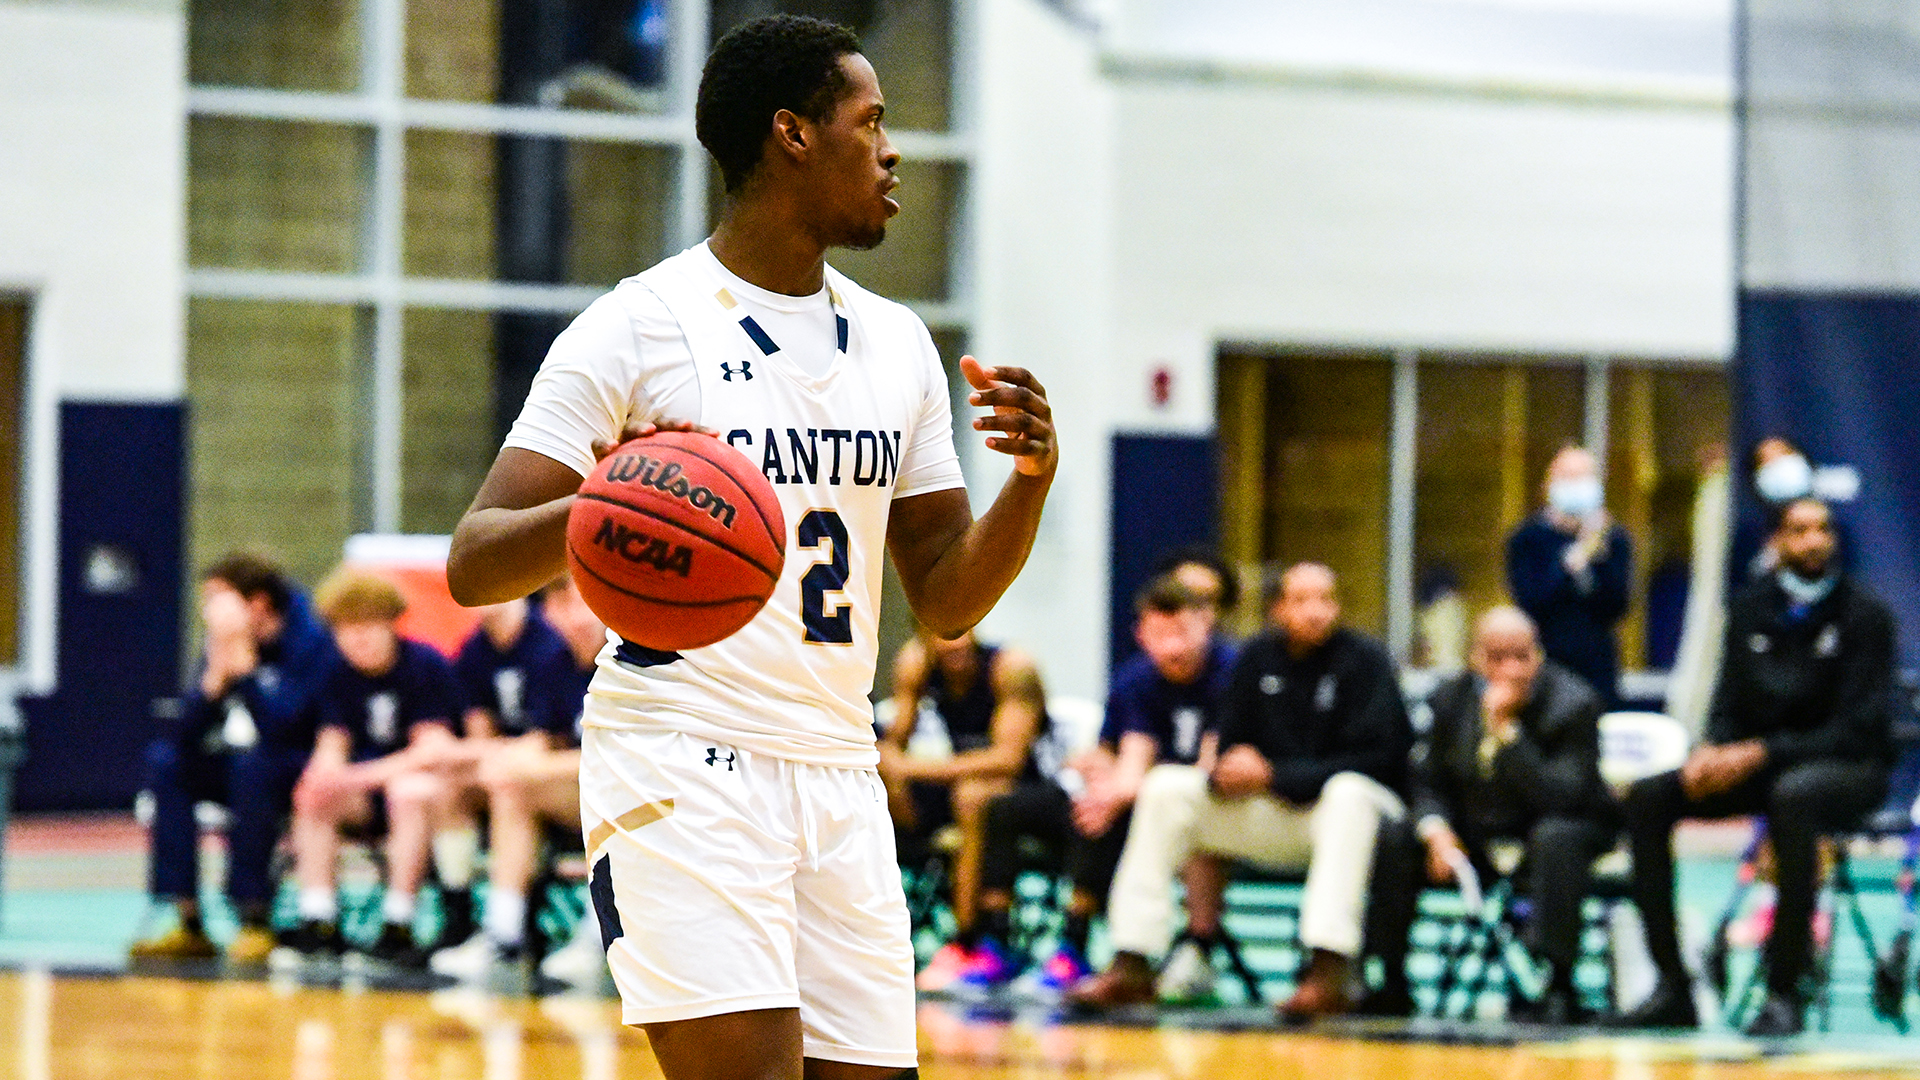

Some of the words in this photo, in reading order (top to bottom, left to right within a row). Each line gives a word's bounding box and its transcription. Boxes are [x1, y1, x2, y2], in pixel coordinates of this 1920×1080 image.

[606, 454, 736, 530] Wilson
[593, 517, 693, 577] NCAA
[796, 507, 853, 646] 2
